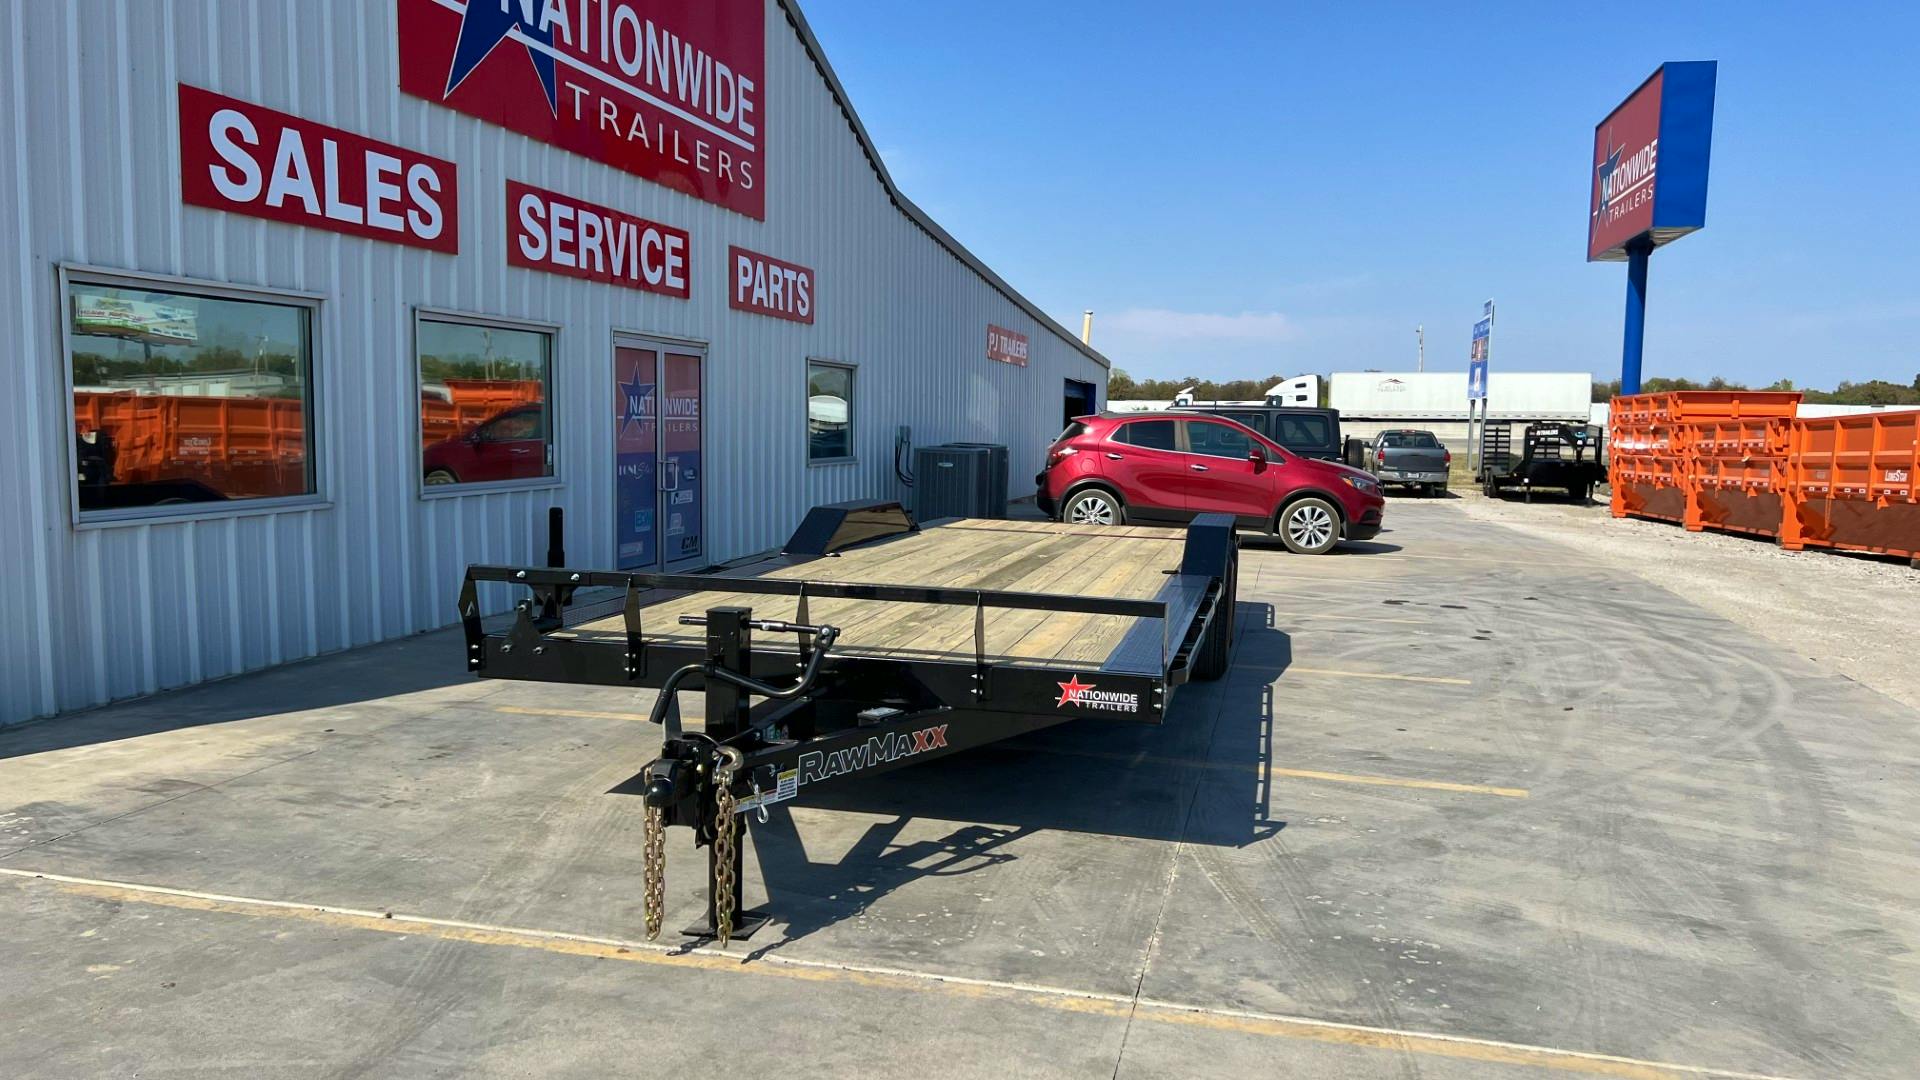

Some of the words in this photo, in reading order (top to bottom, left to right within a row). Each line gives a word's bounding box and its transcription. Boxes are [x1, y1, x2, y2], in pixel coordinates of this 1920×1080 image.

[500, 0, 755, 136] ATIONWIDE
[565, 81, 753, 190] TRAILERS
[209, 109, 443, 240] SALES
[1601, 138, 1658, 204] NATIONWIDE
[1609, 183, 1655, 222] TRAILERS
[518, 194, 685, 290] SERVICE
[737, 255, 809, 317] PARTS
[989, 332, 999, 352] PJ
[1000, 335, 1027, 359] TRAILERS
[629, 395, 698, 416] NATINWIDE
[643, 422, 698, 433] TRILERS
[1068, 689, 1138, 704] NATIONWIDE
[1085, 701, 1138, 713] TRAILERS
